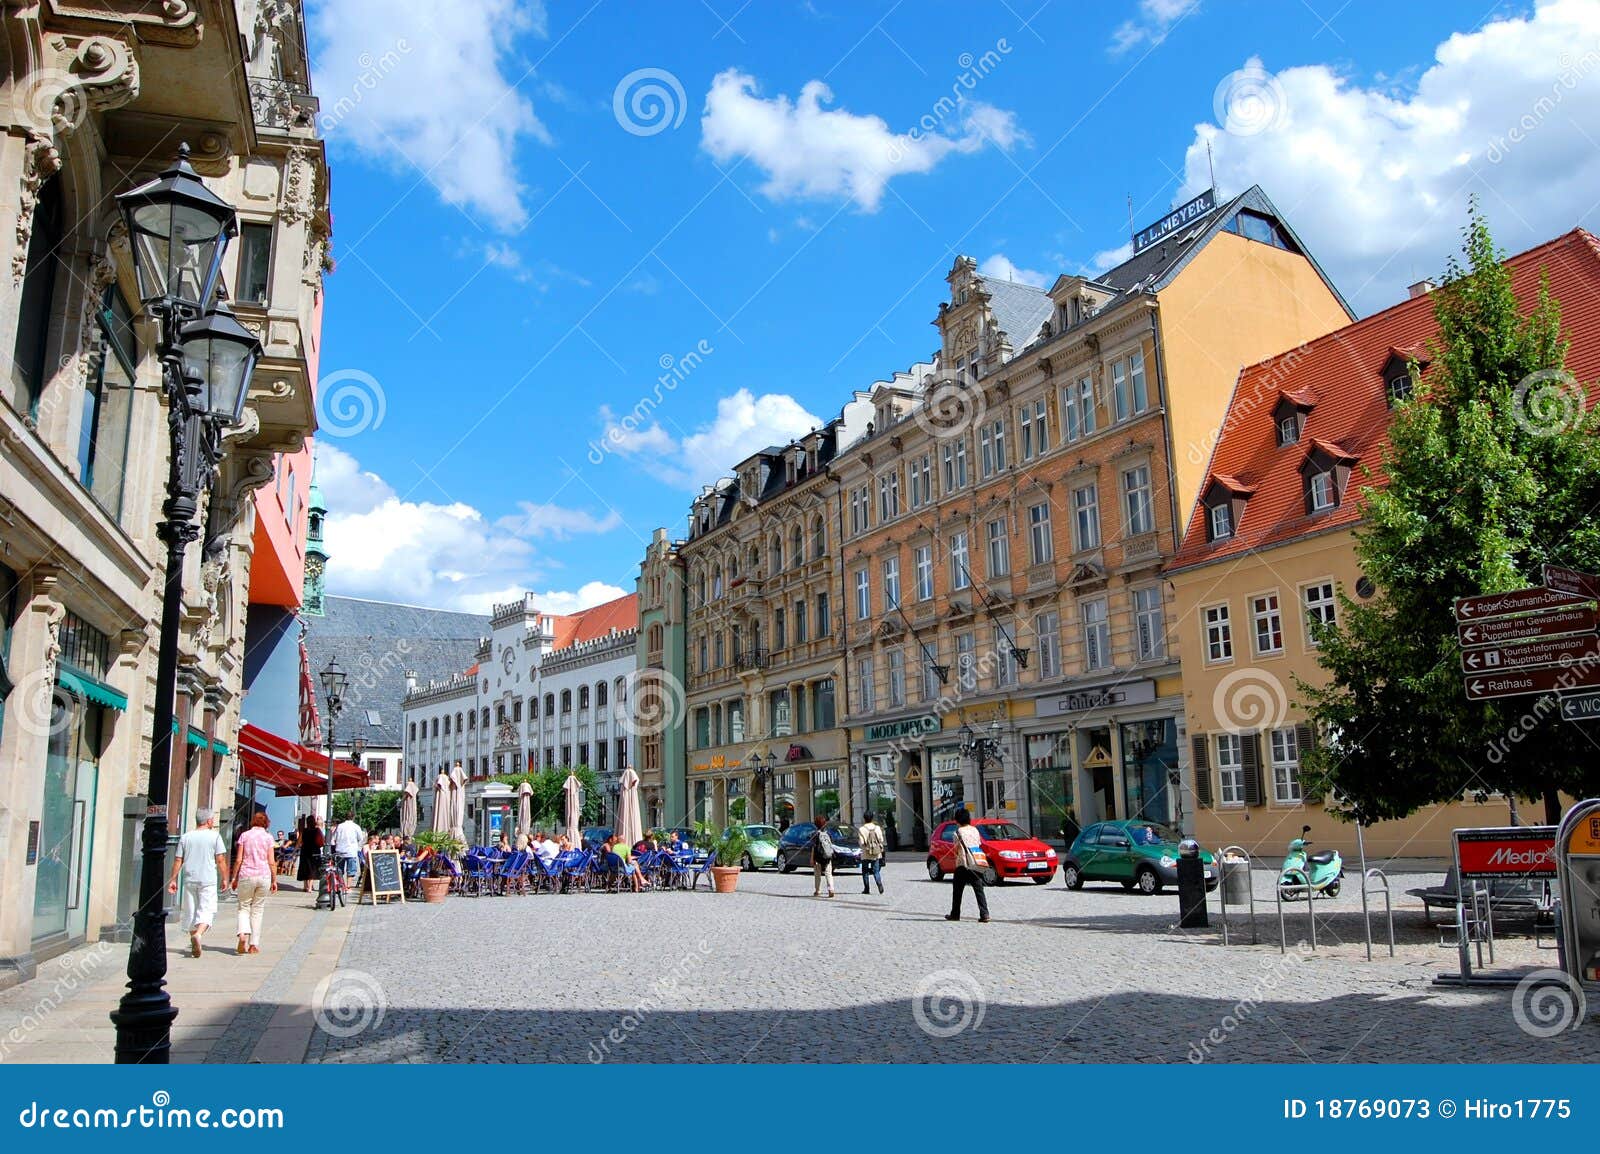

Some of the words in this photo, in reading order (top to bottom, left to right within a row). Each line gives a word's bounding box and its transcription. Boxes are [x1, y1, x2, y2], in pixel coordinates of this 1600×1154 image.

[1481, 621, 1512, 632] Theater
[1527, 612, 1584, 626] Gewandhaus
[1481, 627, 1543, 641] Puppentheater
[1503, 653, 1553, 665] Hauptmarkt
[1488, 679, 1533, 691] Rathaus
[1579, 698, 1600, 713] WC
[871, 724, 898, 739] MODE
[1487, 847, 1545, 865] Media
